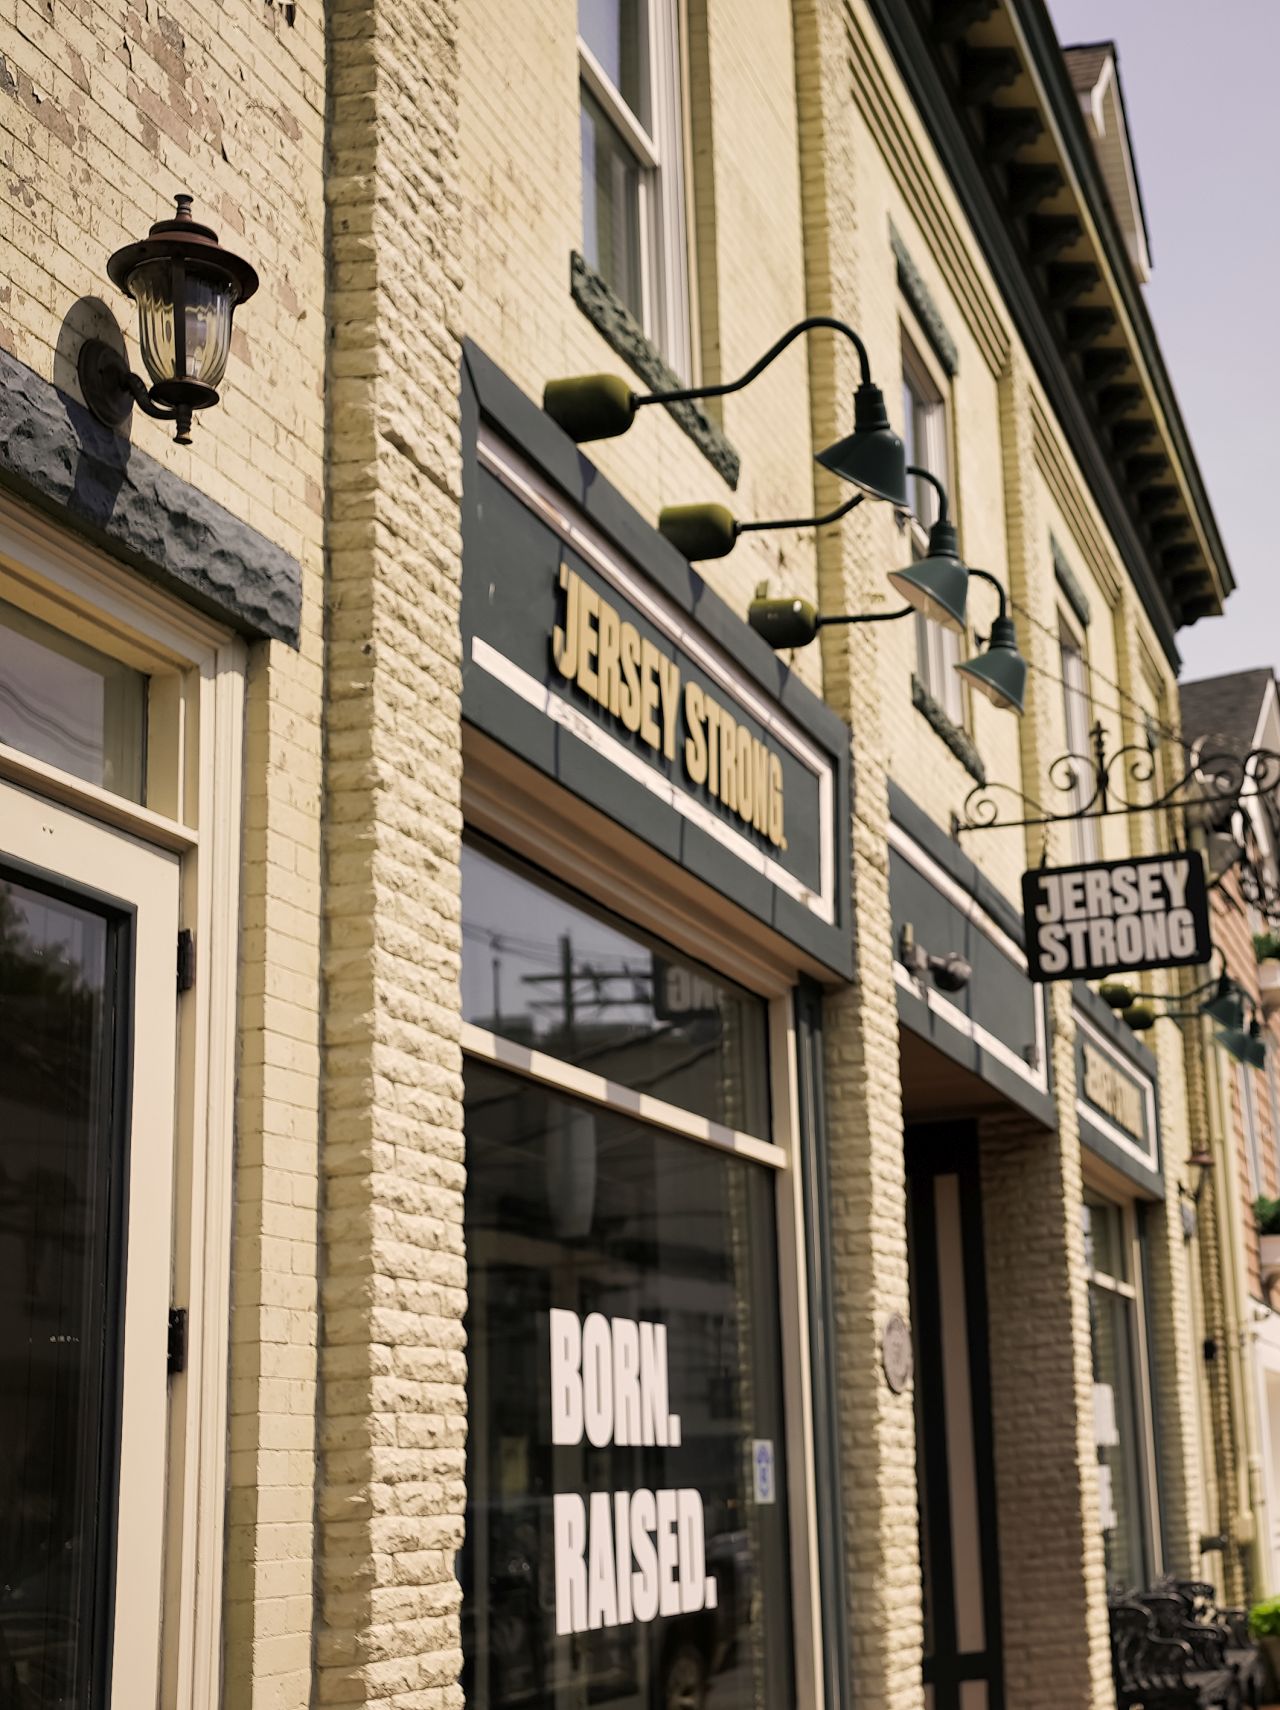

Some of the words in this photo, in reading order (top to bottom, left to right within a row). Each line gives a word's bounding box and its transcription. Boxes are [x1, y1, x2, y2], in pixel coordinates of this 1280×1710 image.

[552, 562, 681, 762] JERSEY
[1035, 859, 1190, 924] JERSEY
[549, 1307, 682, 1448] BORN.
[553, 1488, 718, 1635] RAISED.
